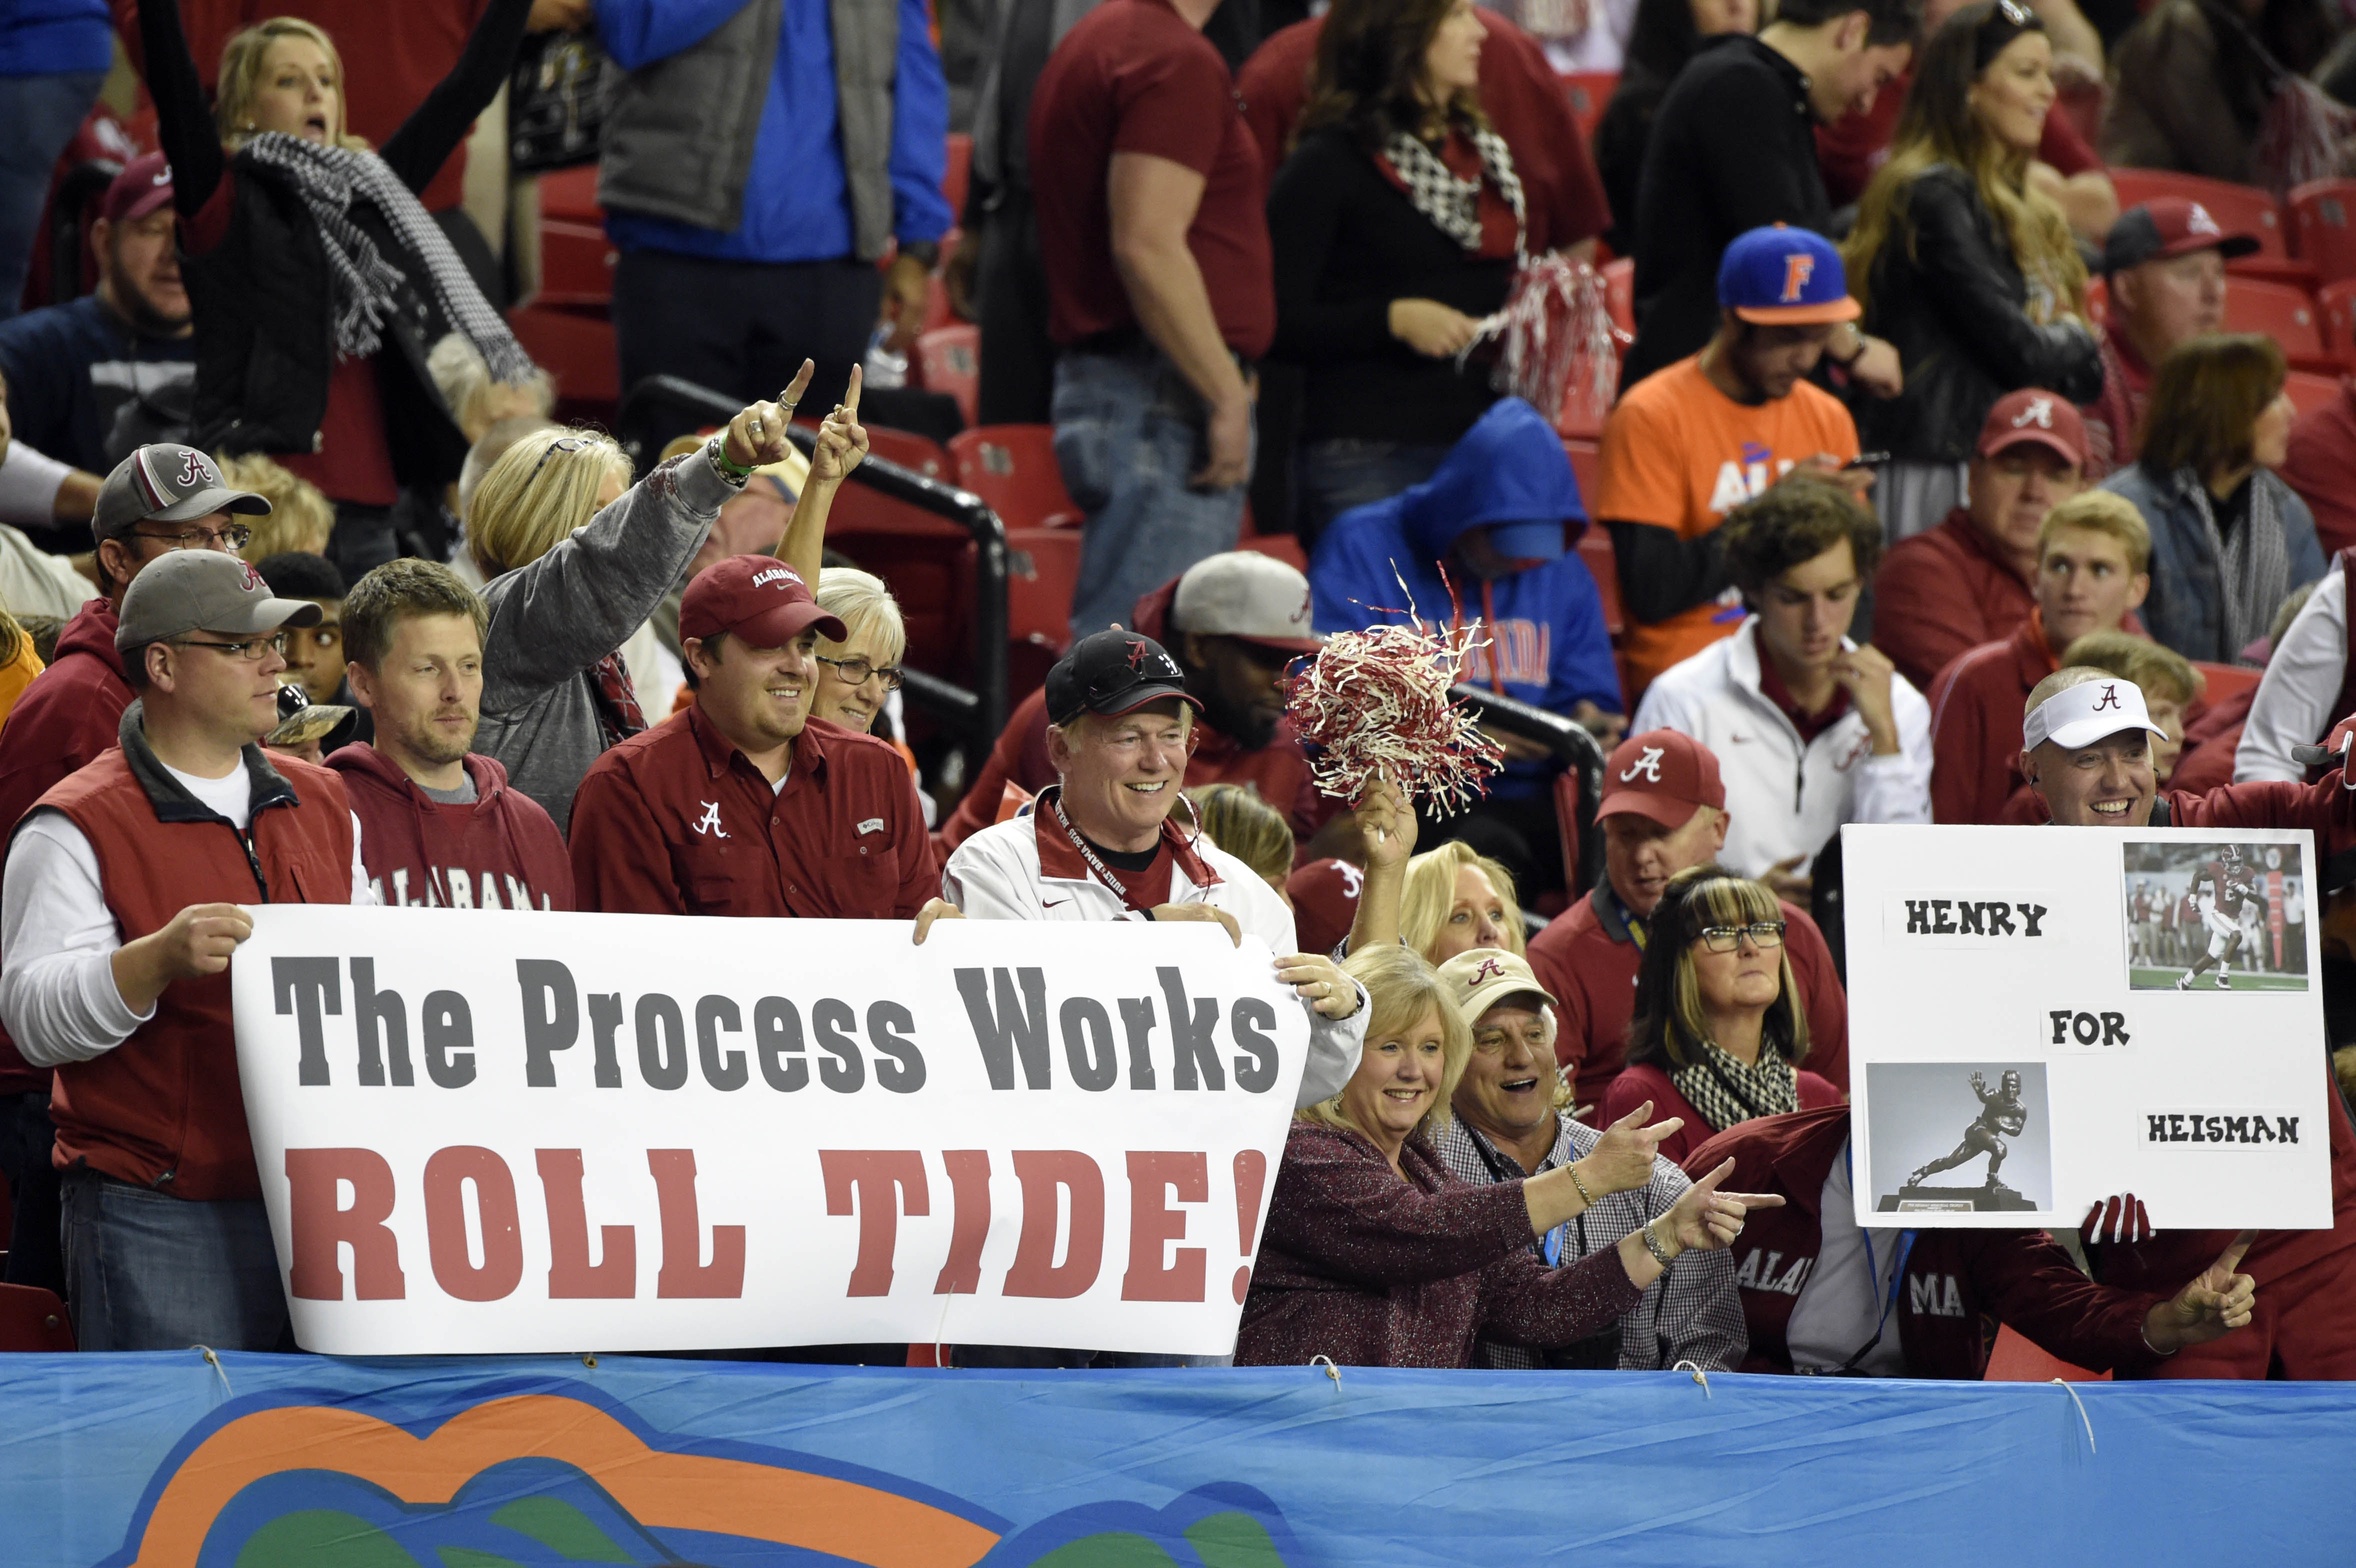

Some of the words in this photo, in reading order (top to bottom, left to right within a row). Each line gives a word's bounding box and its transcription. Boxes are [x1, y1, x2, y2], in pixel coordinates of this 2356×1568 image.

[1780, 254, 1814, 302] F
[177, 452, 213, 486] A
[237, 560, 266, 592] A
[752, 569, 804, 588] ALABAMA
[2092, 684, 2121, 711] A
[1620, 745, 1665, 783] A
[692, 799, 728, 838] A
[1067, 828, 1085, 848] 2015
[1081, 844, 1104, 873] BAMA
[1905, 899, 2048, 937] HENRY
[1468, 958, 1506, 986] A
[271, 956, 477, 1089] The
[515, 959, 927, 1094] Process
[954, 967, 1279, 1094] Works
[2049, 1010, 2131, 1047] FOR
[2147, 1113, 2300, 1145] HEISMAN
[285, 1146, 745, 1301] ROLL
[818, 1149, 1266, 1304] TIDE!
[1736, 1248, 1815, 1296] ALA
